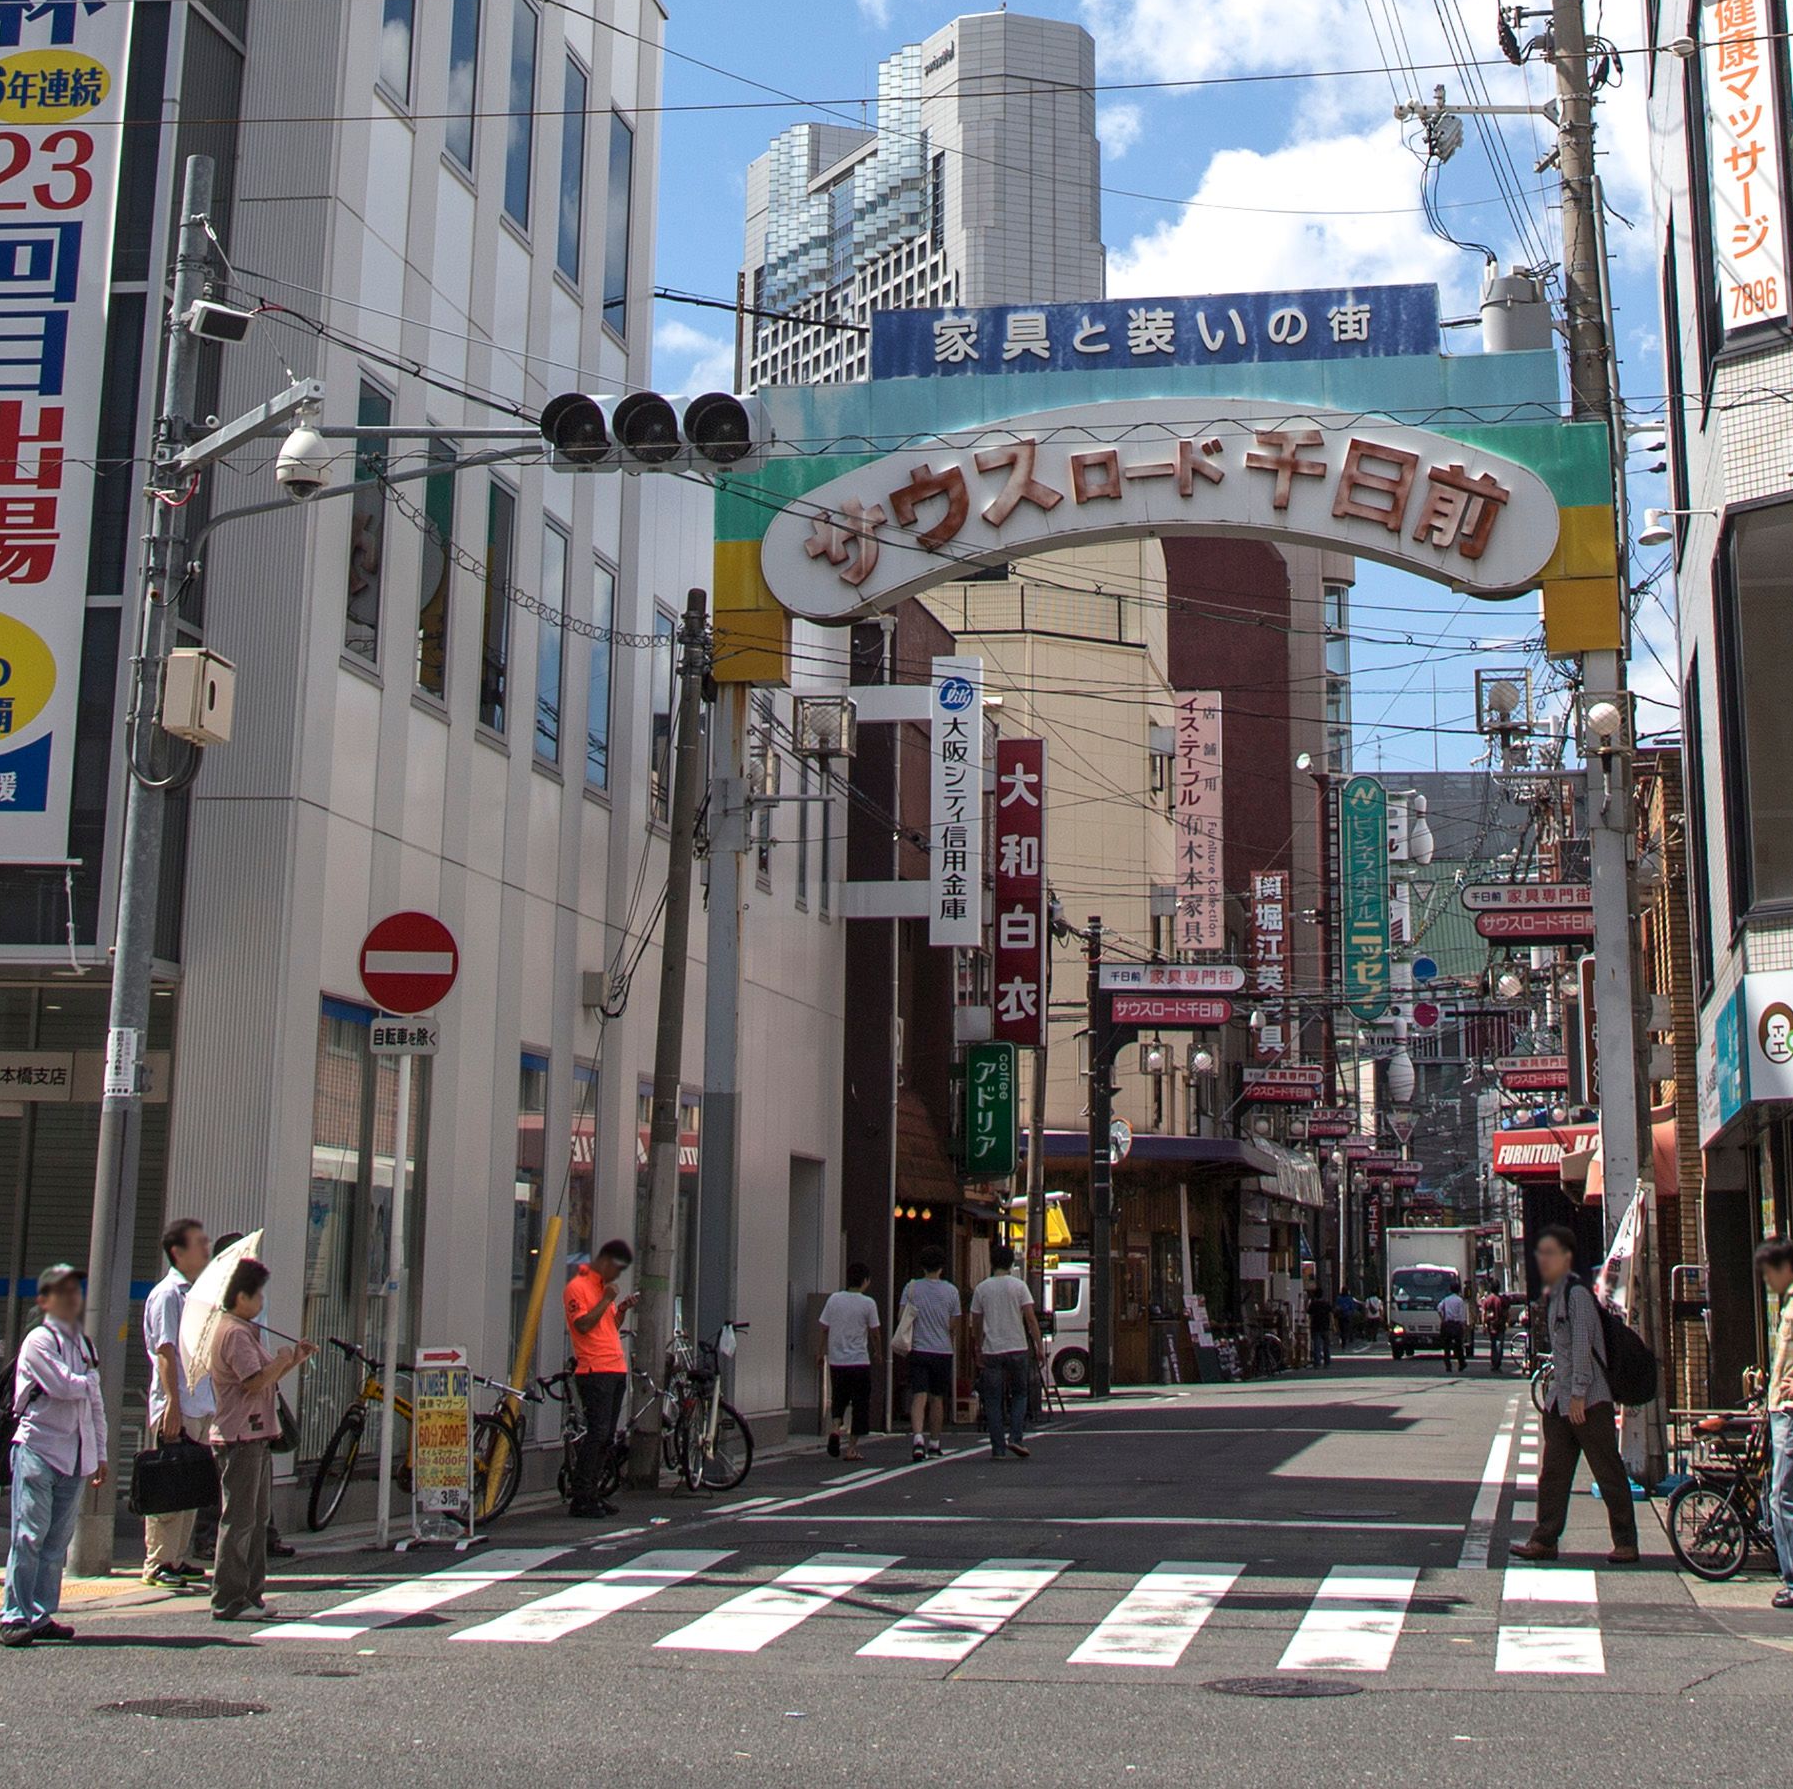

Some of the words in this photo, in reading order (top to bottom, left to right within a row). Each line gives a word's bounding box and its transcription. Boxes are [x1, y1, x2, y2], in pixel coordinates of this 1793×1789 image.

[1729, 276, 1777, 318] 7896
[933, 303, 1373, 363] 家具と装いの街
[804, 427, 1509, 588] サウスロード千日前
[939, 717, 968, 921] 大阪シティ信用金庫
[999, 763, 1039, 1022] 大和白衣
[1471, 891, 1501, 902] 千日前
[1507, 889, 1590, 903] 家具専門街
[1111, 972, 1141, 982] 千日前
[1150, 970, 1234, 985] 家具専門街
[1116, 1002, 1224, 1018] サウスロード千日前
[374, 1028, 436, 1046] 自転車を除く
[975, 1061, 997, 1157] アドリア
